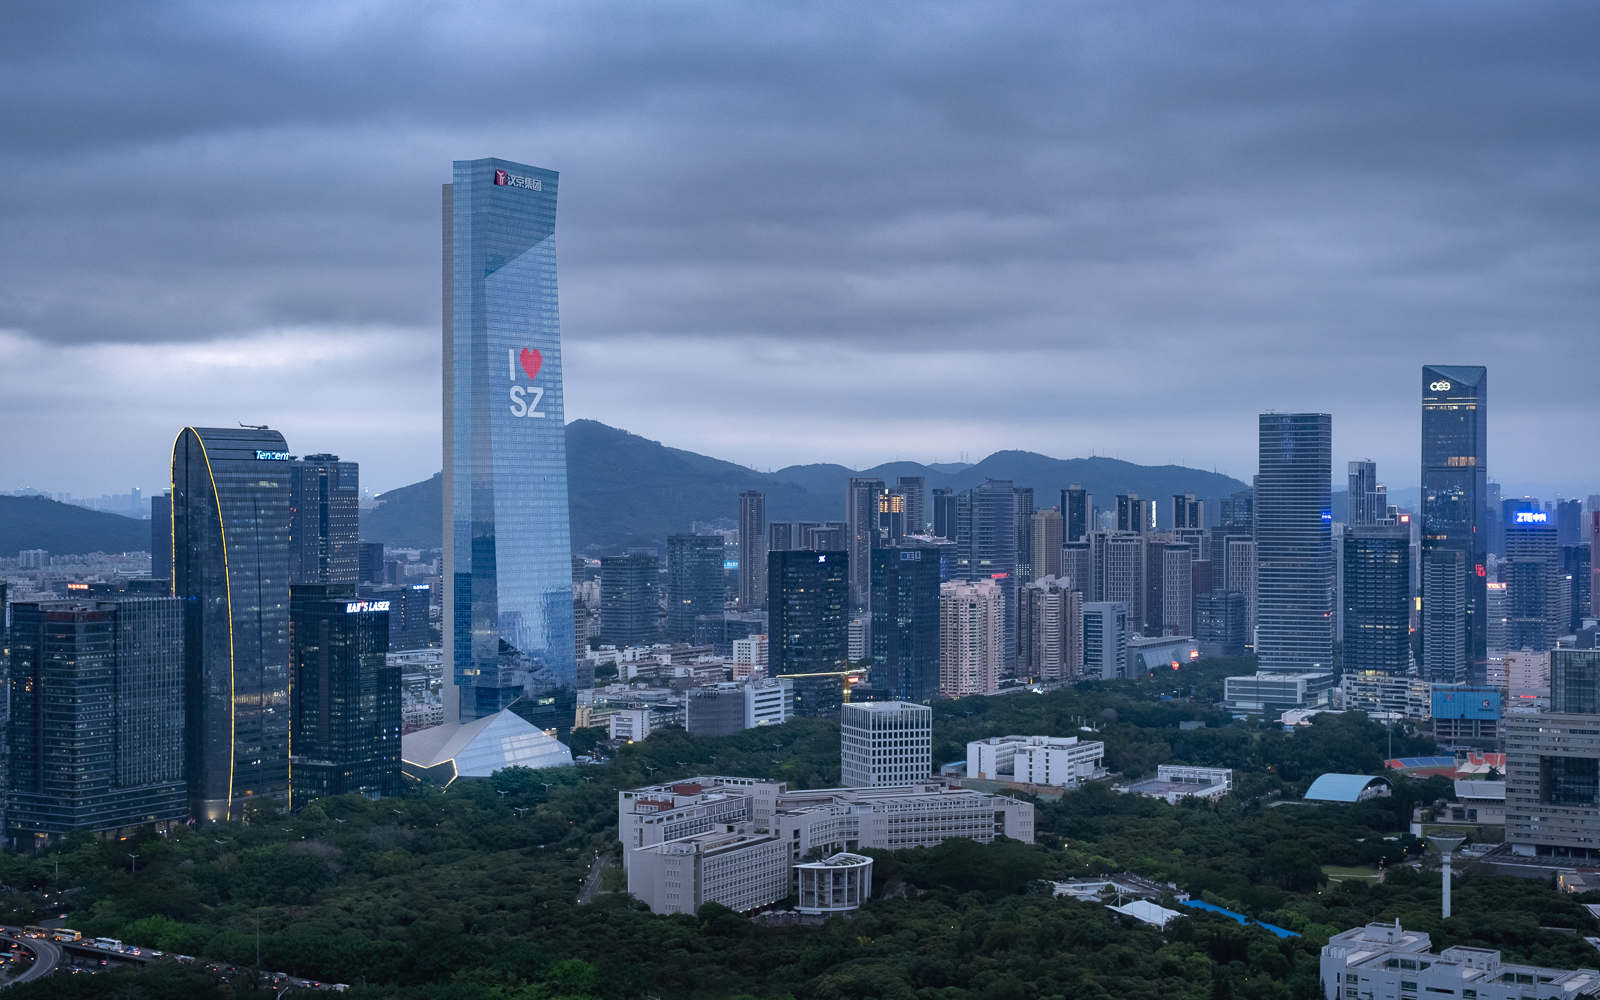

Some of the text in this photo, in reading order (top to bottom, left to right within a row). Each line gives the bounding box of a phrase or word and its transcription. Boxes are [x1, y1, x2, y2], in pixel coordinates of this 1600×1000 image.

[507, 175, 542, 191] 汉京集团
[509, 349, 516, 381] I
[510, 385, 546, 417] SZ
[256, 450, 290, 460] Tencent
[369, 601, 390, 611] LASER
